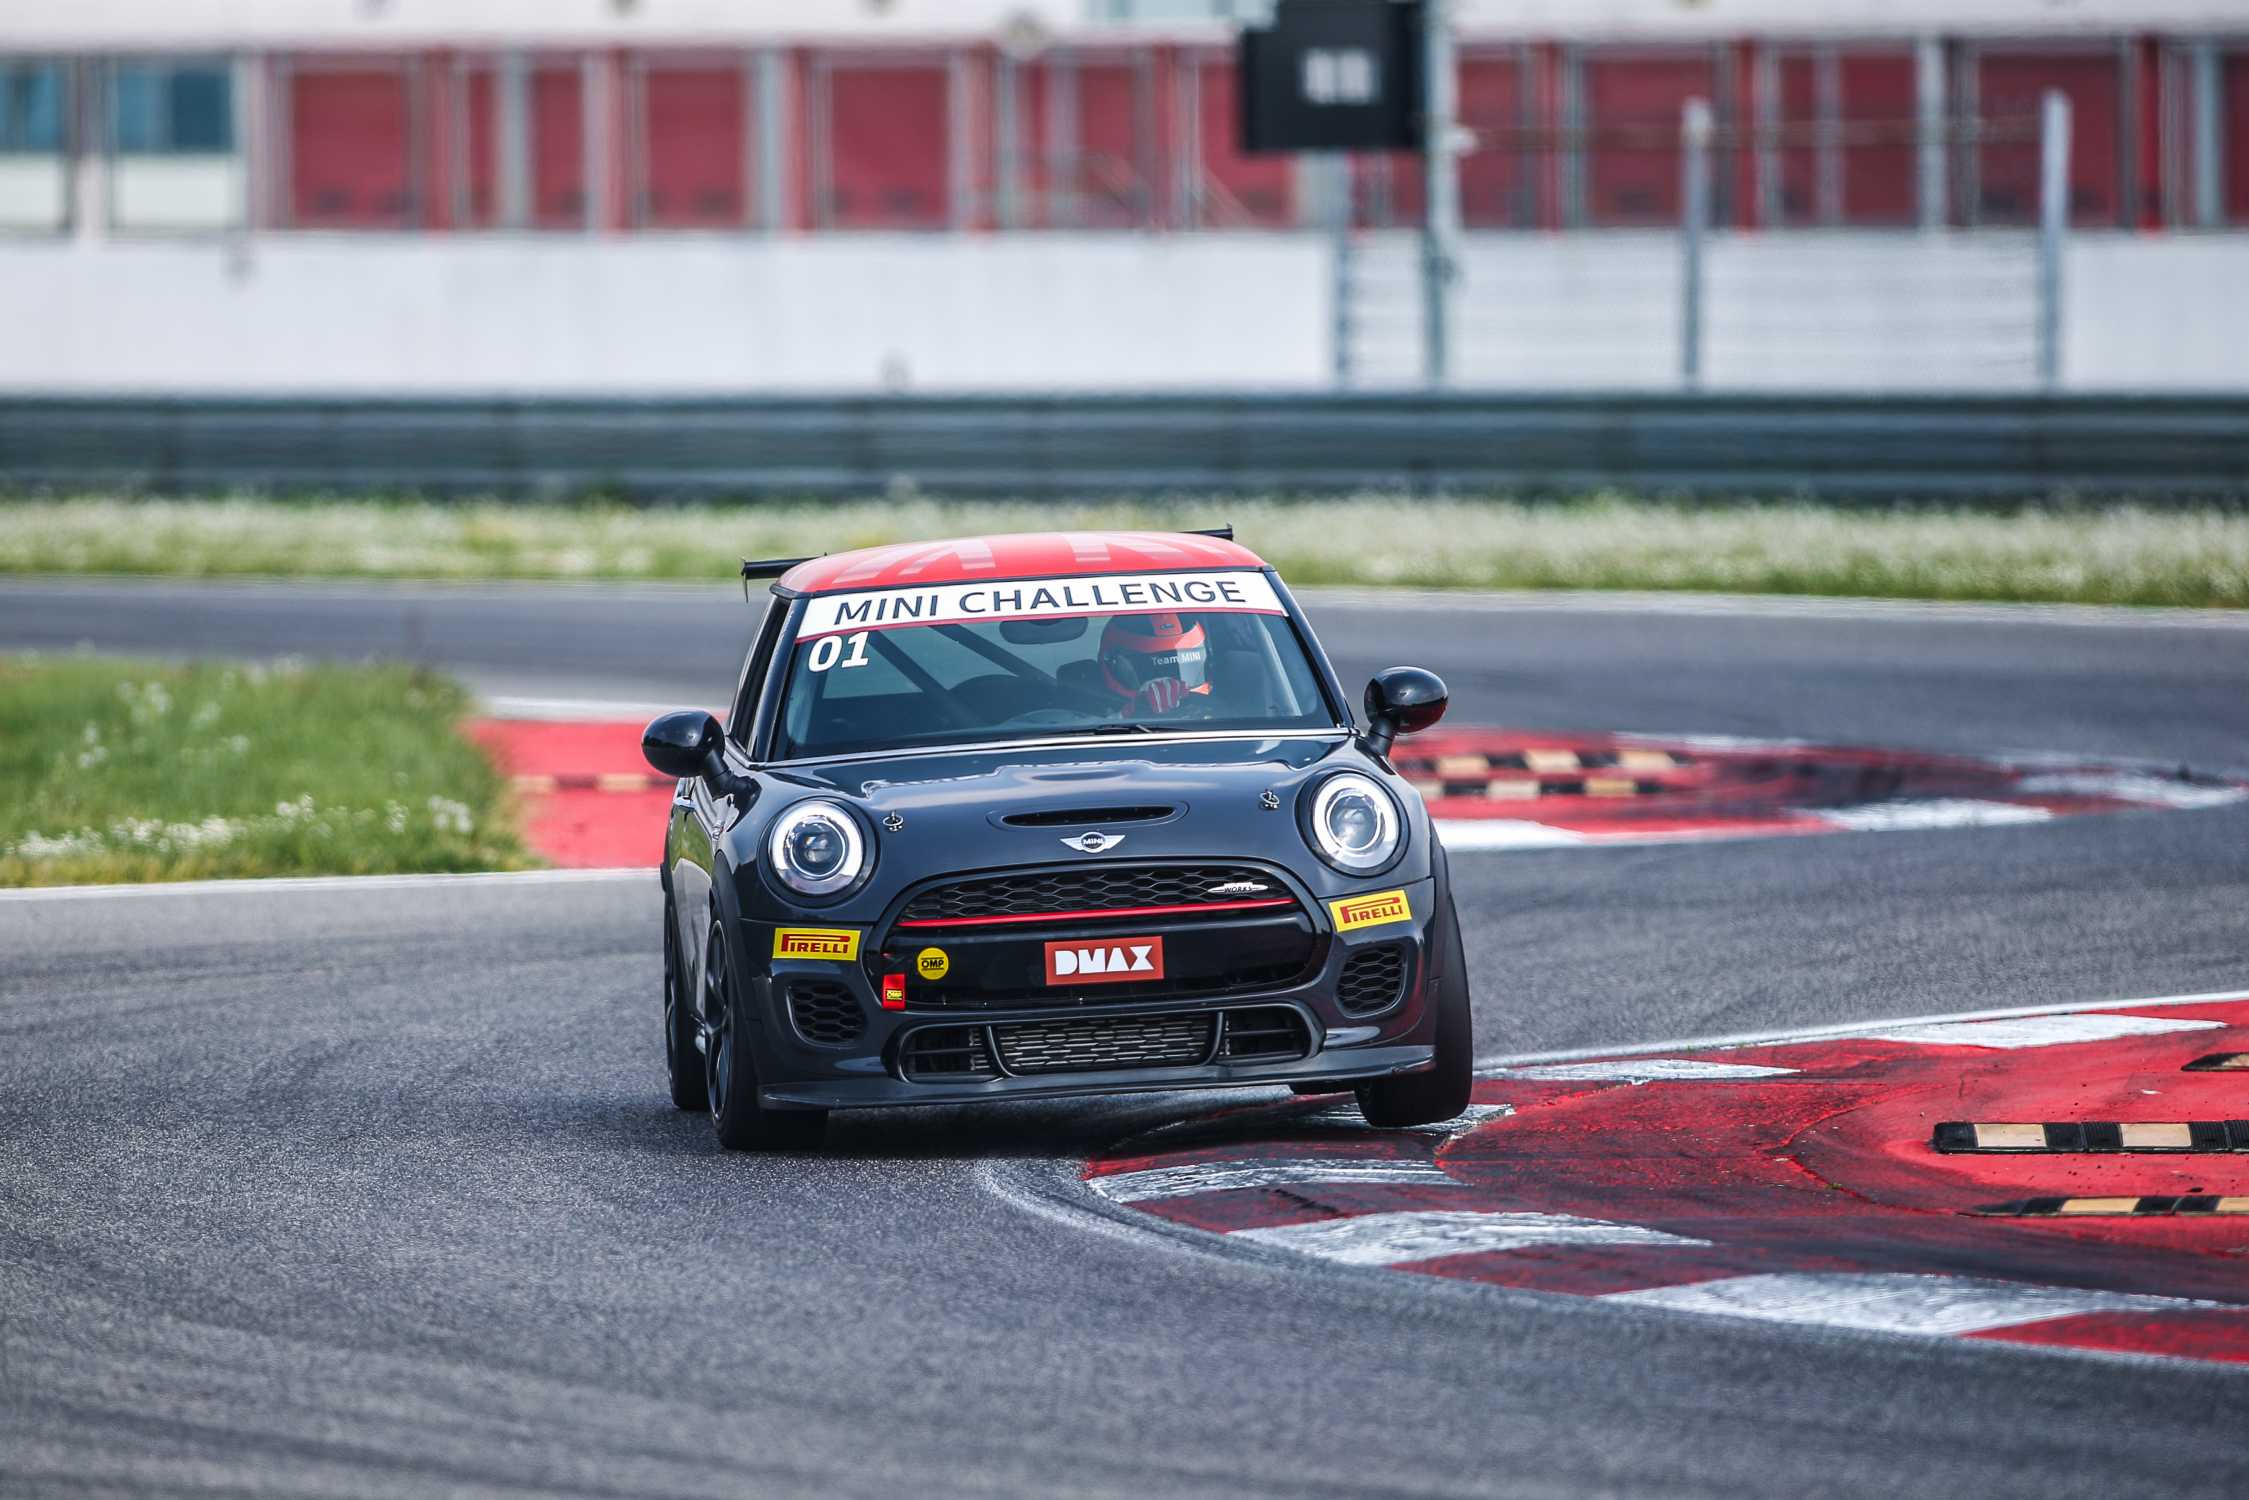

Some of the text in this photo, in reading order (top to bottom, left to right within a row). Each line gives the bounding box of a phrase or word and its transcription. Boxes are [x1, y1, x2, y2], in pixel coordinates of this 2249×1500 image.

[833, 580, 1246, 625] MINI CHALLENGE
[807, 631, 870, 672] 01
[1152, 655, 1178, 665] Team
[1341, 897, 1403, 924] PIRELLI
[780, 933, 851, 954] PIRELLI
[921, 959, 944, 969] OMP
[1054, 945, 1155, 975] DMAX
